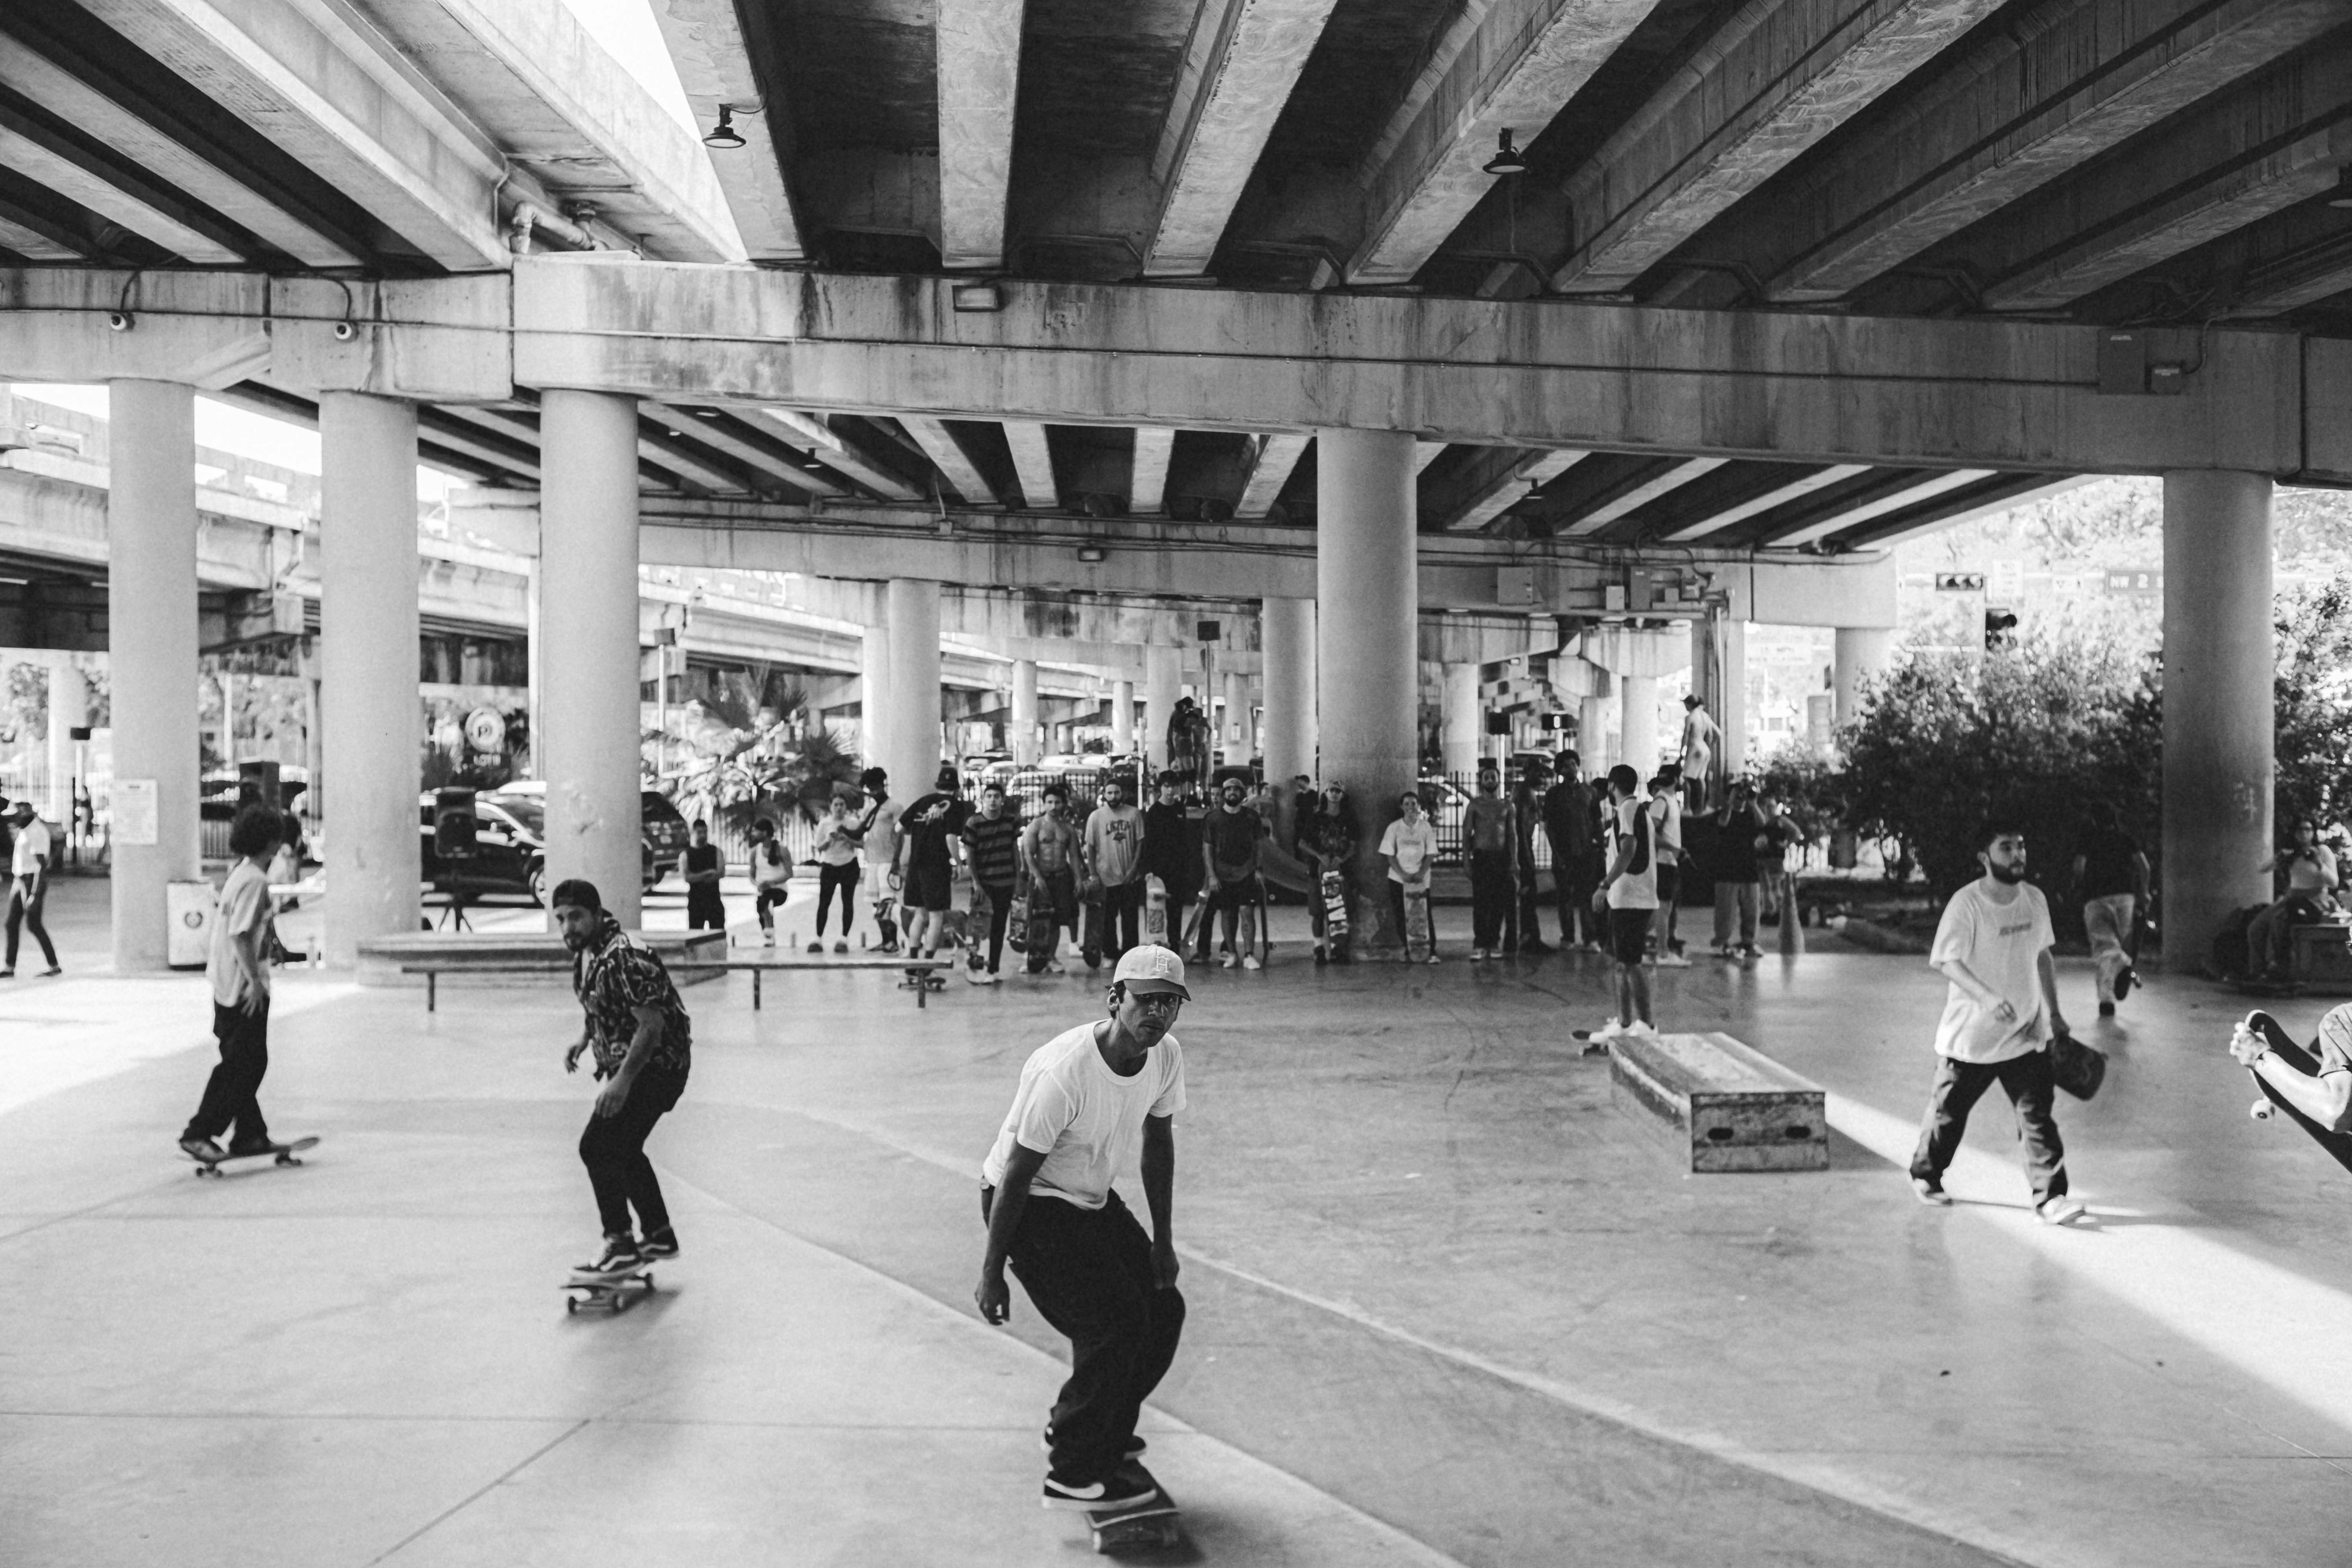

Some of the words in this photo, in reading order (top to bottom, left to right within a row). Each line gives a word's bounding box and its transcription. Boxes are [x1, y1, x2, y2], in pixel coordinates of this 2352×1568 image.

[2110, 576, 2129, 588] NW
[2137, 573, 2149, 588] 2
[1155, 956, 1169, 973] H
